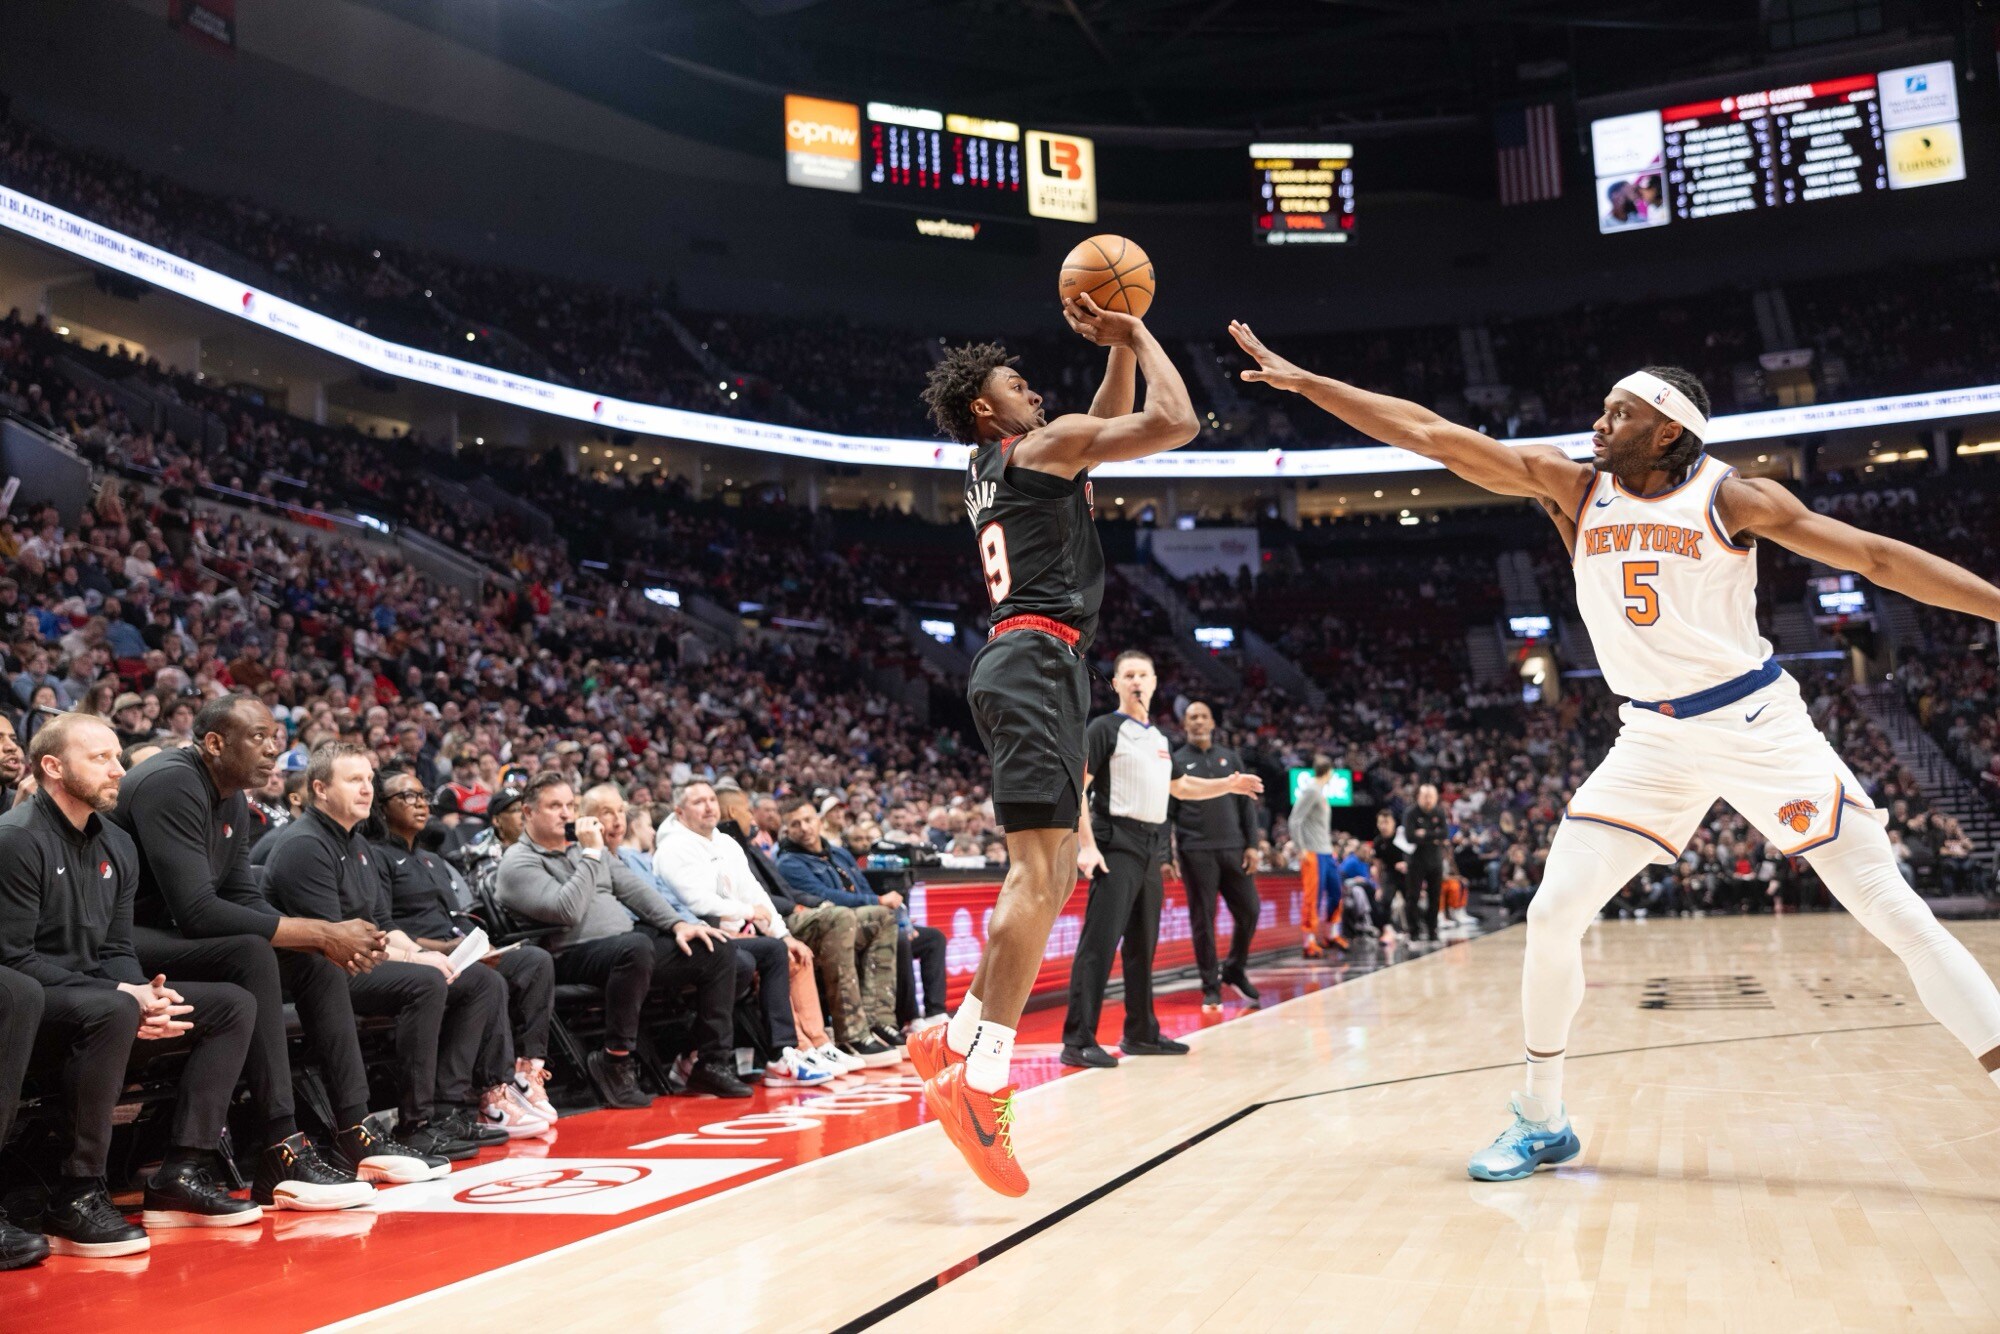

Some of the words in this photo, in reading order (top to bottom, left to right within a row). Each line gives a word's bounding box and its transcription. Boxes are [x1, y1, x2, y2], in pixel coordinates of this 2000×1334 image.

[787, 119, 858, 146] opnw
[1584, 523, 1635, 557] NEW
[1637, 523, 1704, 561] YORK
[979, 520, 1012, 604] 9
[1622, 560, 1661, 627] 5
[1778, 799, 1819, 824] KNICKS
